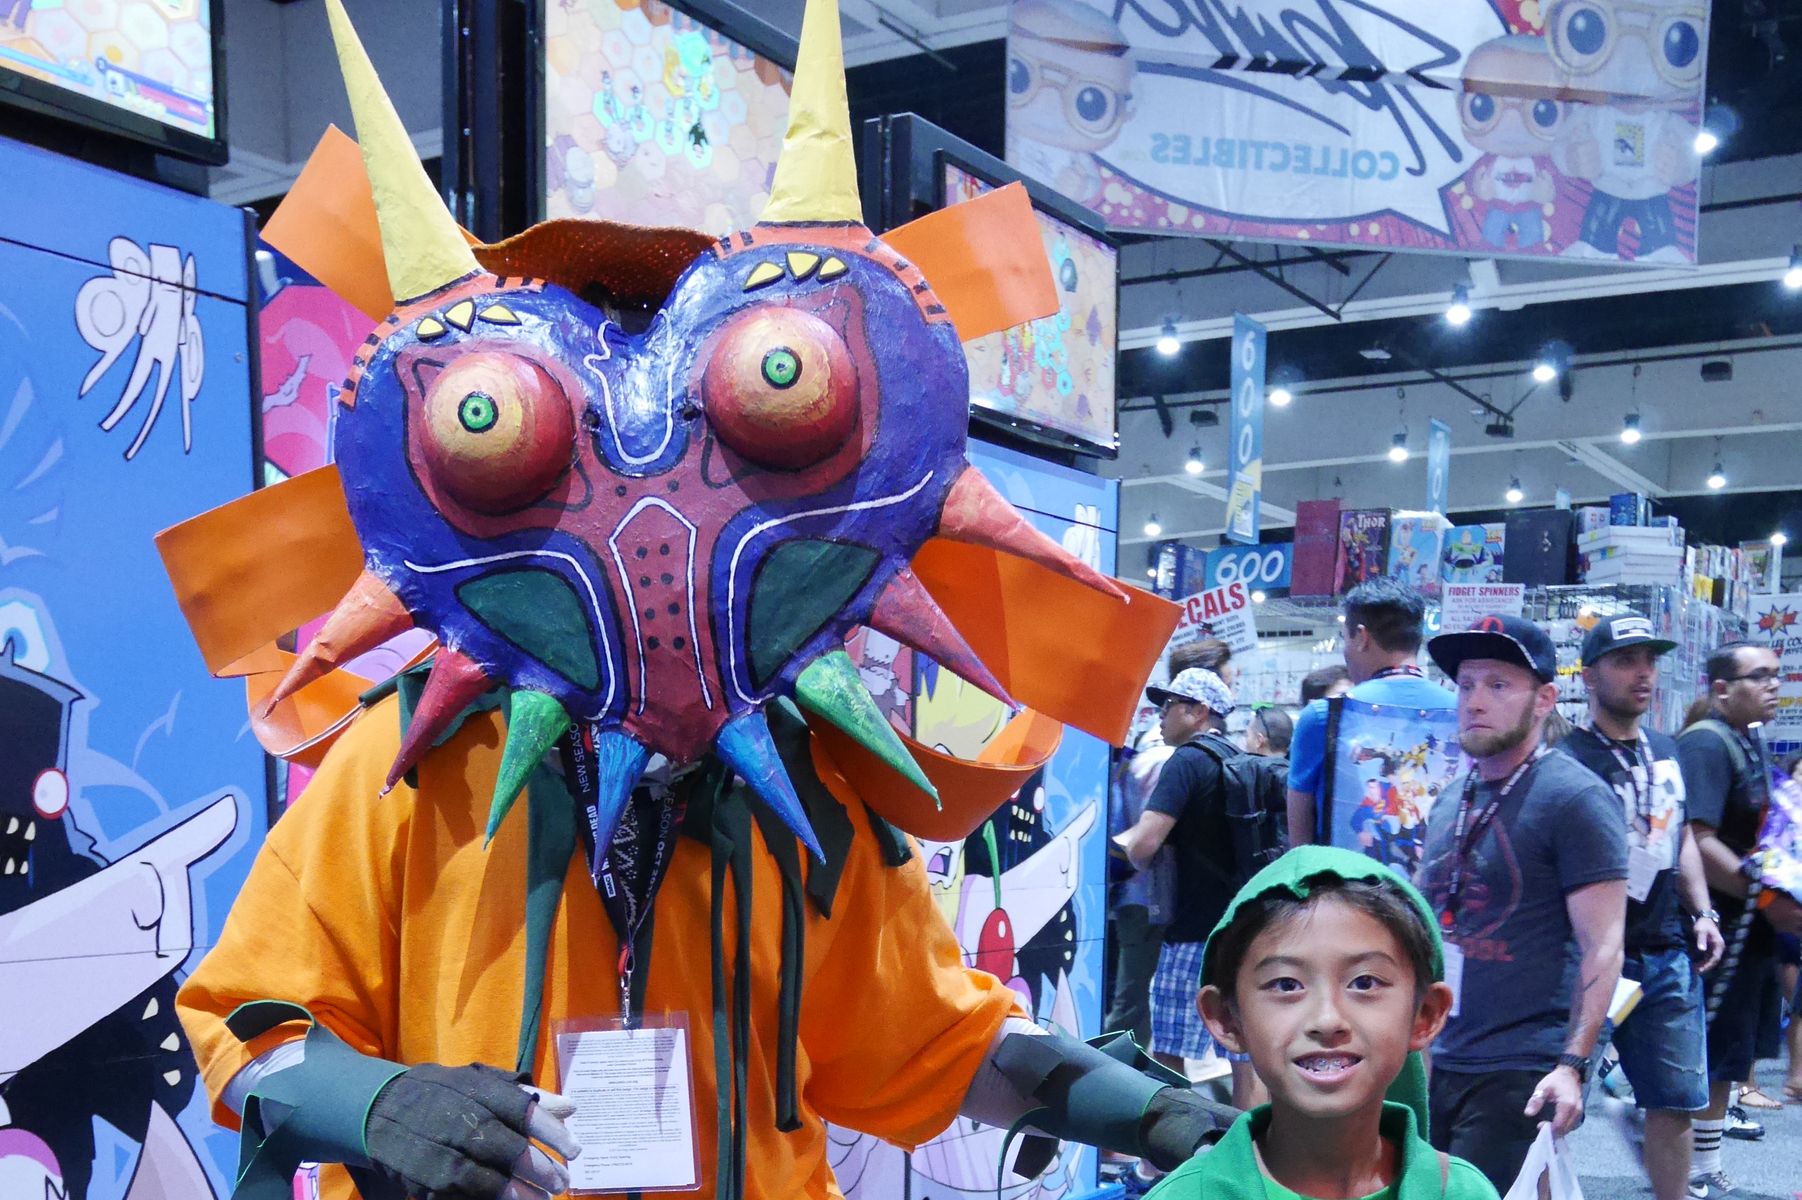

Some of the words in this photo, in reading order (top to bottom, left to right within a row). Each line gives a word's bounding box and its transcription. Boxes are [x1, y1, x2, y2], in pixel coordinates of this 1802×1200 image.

[1238, 330, 1256, 465] 600
[1357, 514, 1386, 530] THOR
[1215, 550, 1284, 585] 600
[1178, 582, 1246, 629] CALS
[1448, 587, 1476, 597] FIDGET
[1478, 587, 1520, 597] SPINNERS
[569, 723, 585, 762] SEASO
[577, 764, 591, 792] NEW
[656, 841, 665, 866] OCT
